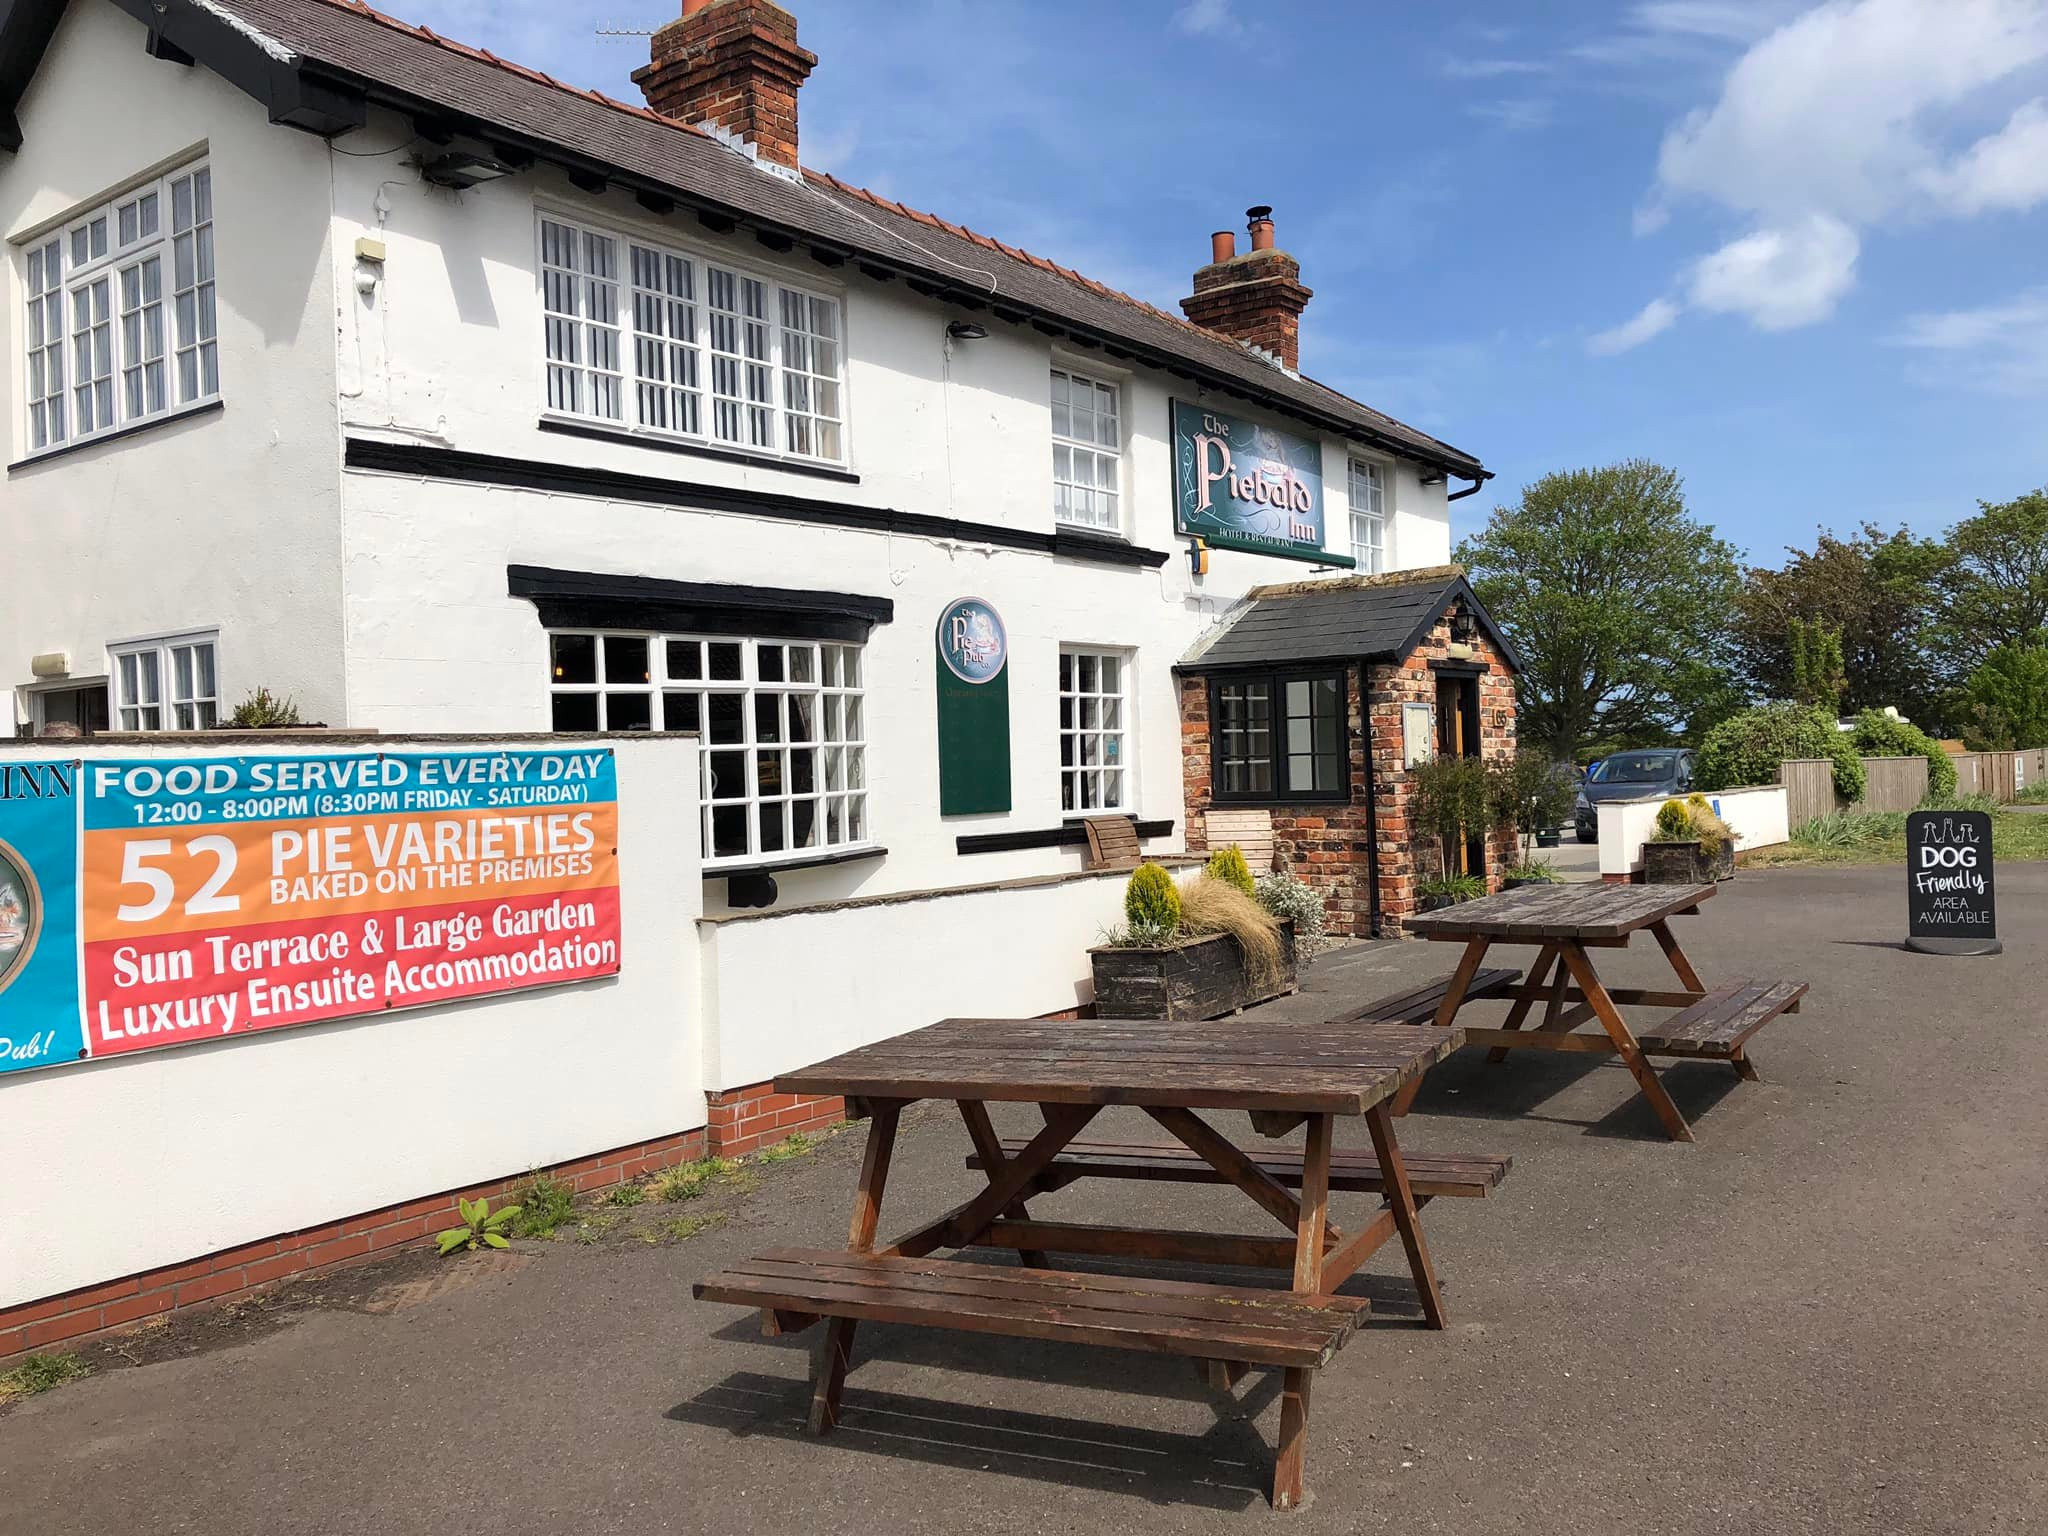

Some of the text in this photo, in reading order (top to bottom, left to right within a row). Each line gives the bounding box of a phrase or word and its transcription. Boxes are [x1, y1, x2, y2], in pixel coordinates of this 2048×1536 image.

[1203, 414, 1230, 436] The
[1193, 431, 1312, 514] Piebald
[1289, 512, 1316, 542] Inn
[0, 763, 73, 800] INN
[94, 754, 605, 798] FOOD SERVED EVERY DAY
[133, 801, 202, 823] 12:00
[222, 796, 309, 819] 8:00PM
[313, 791, 399, 817] (8:30PM
[403, 789, 473, 809] FRIDAY
[487, 783, 589, 806] SATURDAY)
[271, 811, 595, 877] PIE VARIETIES
[1920, 846, 1978, 868] DOG
[116, 834, 241, 922] 52
[270, 852, 594, 905] BAKED ON THE PREMISES
[1915, 869, 1990, 895] Friendly
[1918, 910, 1991, 924] AVAILABLE
[1932, 896, 1970, 910] AREA
[113, 898, 597, 988] Sun Terrace & Large Garden
[98, 934, 617, 1041] Luxury Ensuite Accommodation
